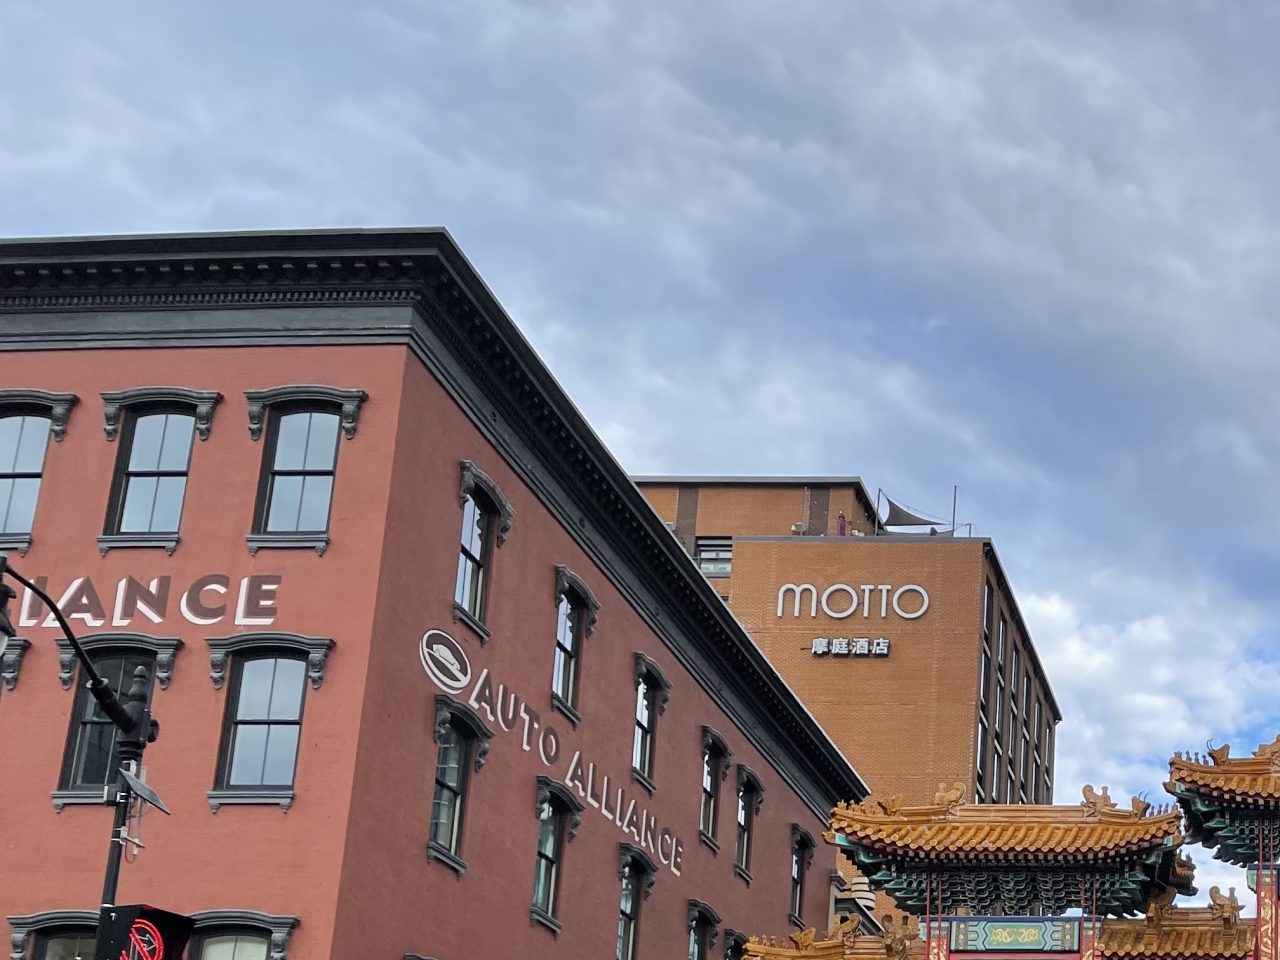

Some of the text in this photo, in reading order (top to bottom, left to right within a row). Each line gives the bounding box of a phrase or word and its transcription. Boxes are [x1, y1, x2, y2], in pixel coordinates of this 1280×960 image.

[19, 574, 282, 627] IANCE
[811, 638, 890, 656] 摩庭酒店
[468, 668, 684, 877] AUTO ALLIANCE
